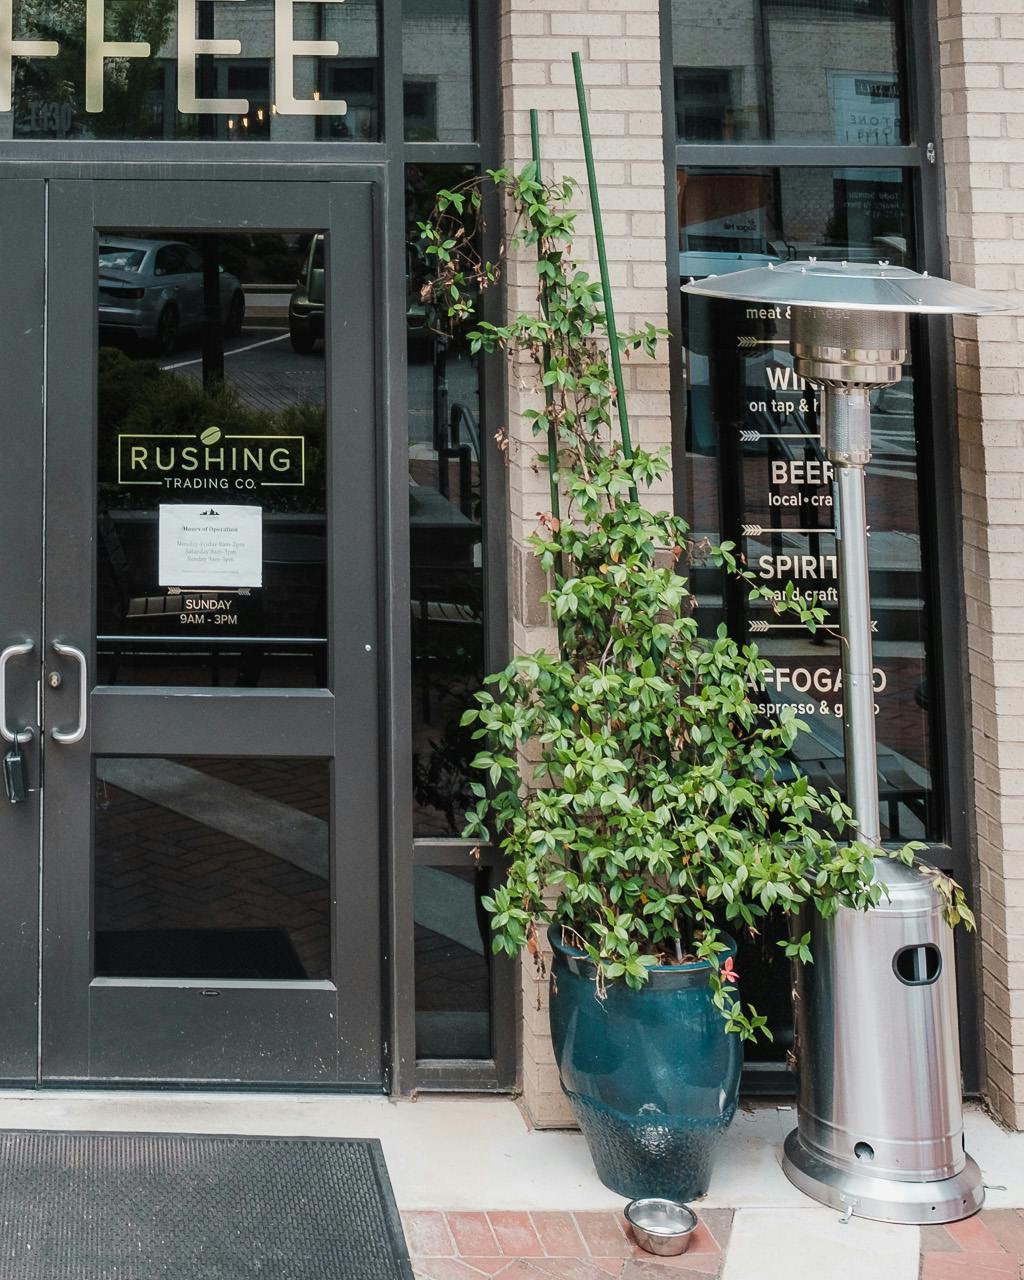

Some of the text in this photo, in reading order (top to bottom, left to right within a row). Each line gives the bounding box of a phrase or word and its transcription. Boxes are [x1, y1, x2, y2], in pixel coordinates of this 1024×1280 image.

[746, 306, 782, 319] meat
[749, 401, 767, 412] on
[771, 400, 794, 415] tap
[799, 399, 809, 412] &
[130, 446, 291, 472] RUSHING
[163, 477, 257, 490] TRADING CO.
[759, 555, 838, 579] SPIRIT
[185, 598, 233, 611] SUNDAY
[179, 613, 205, 625] 9AM
[214, 613, 238, 625] 3PM
[819, 700, 830, 715] &
